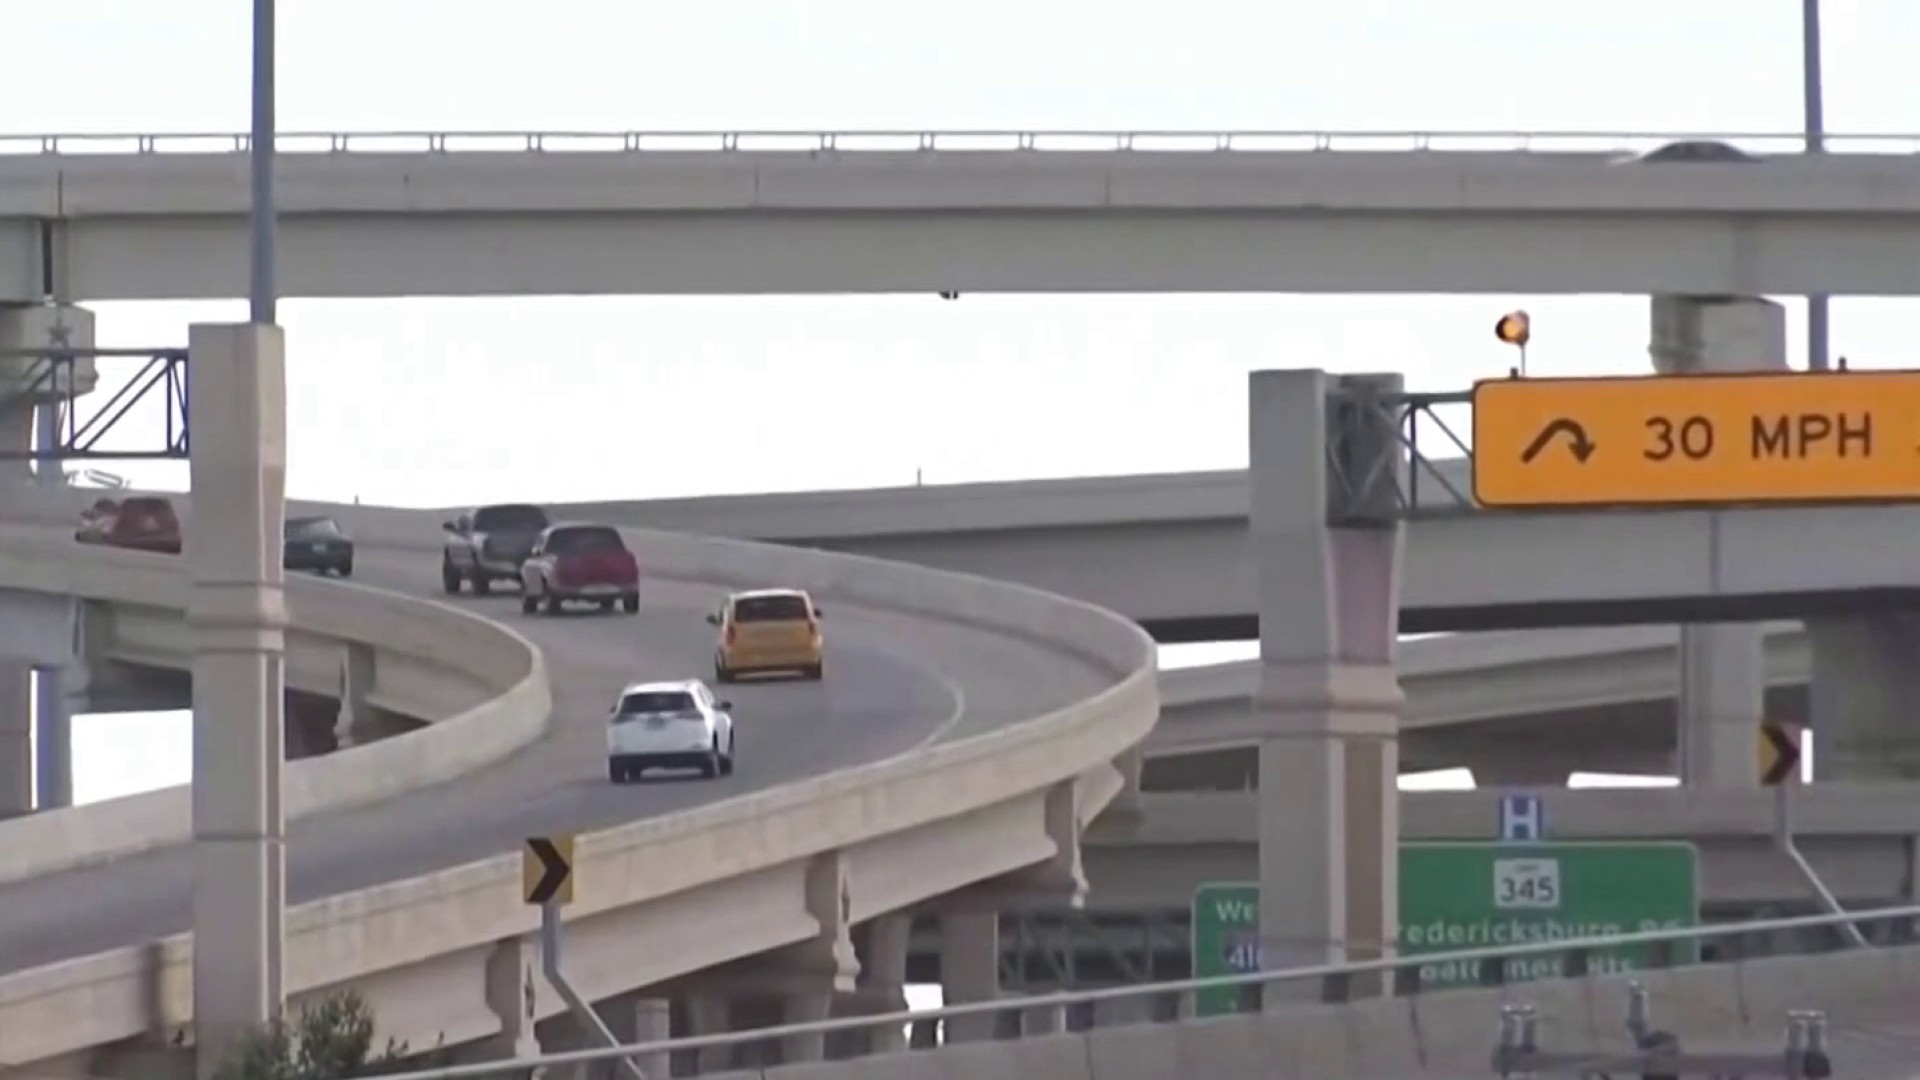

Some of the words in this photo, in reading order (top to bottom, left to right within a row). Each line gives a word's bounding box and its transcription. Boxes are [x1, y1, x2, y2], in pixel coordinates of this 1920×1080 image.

[1643, 415, 1714, 461] 30
[1750, 412, 1872, 460] MPH
[1503, 797, 1538, 840] H
[1500, 875, 1555, 902] 345
[1216, 900, 1260, 921] We
